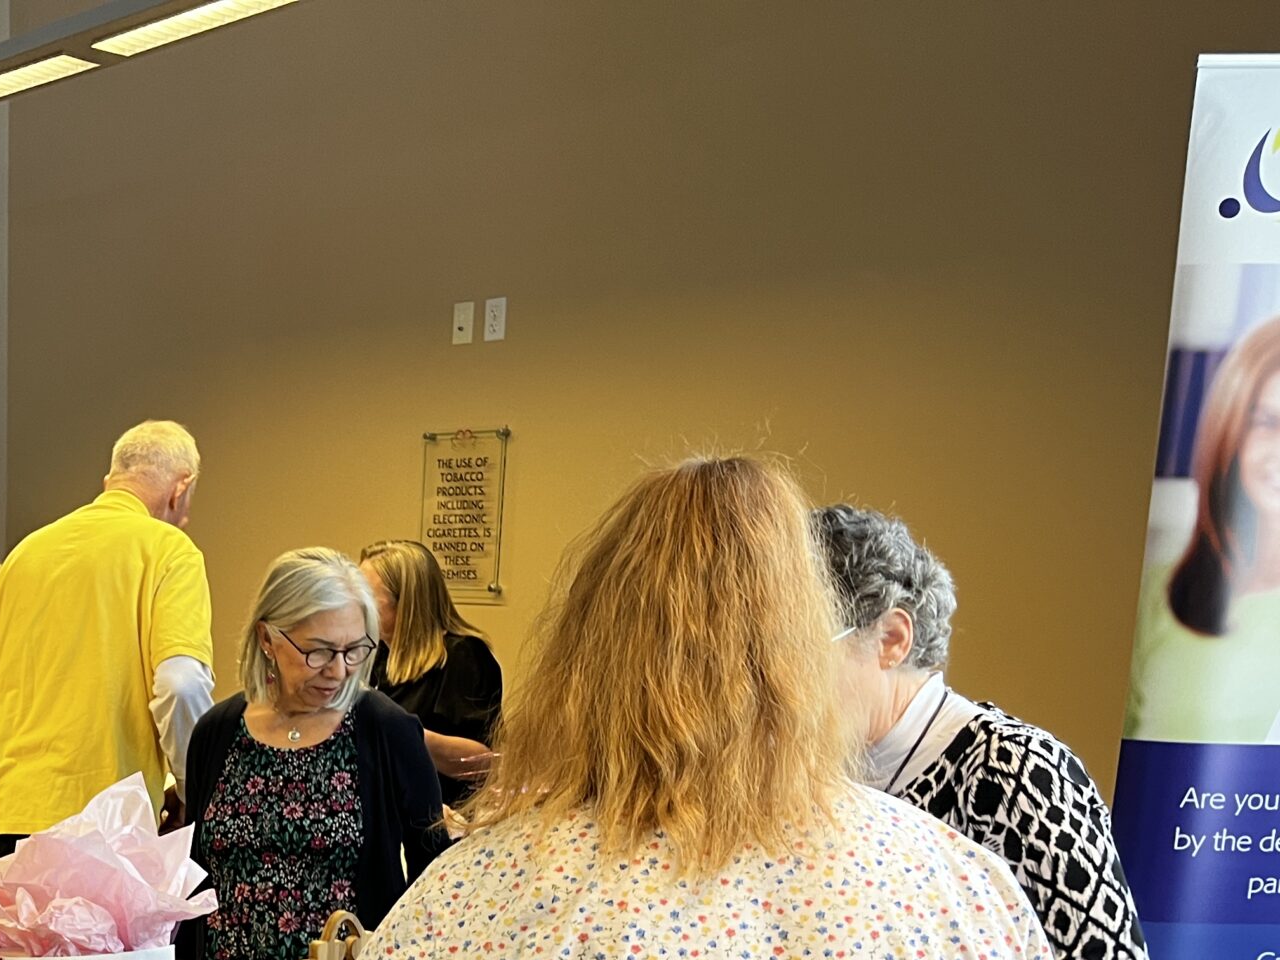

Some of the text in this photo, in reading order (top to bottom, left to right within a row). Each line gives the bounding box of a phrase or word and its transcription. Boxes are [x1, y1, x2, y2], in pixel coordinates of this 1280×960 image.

[437, 457, 489, 469] THE USE OF
[440, 471, 484, 482] TOBACCO
[437, 500, 484, 511] INCLUDING
[433, 514, 487, 525] ELECTRONIC
[483, 527, 491, 538] IS
[433, 542, 484, 552] BANNED ON
[444, 556, 470, 566] THESE
[441, 569, 477, 580] REMISES
[1179, 786, 1280, 816] Are you
[1173, 826, 1206, 857] by
[1213, 828, 1252, 852] the
